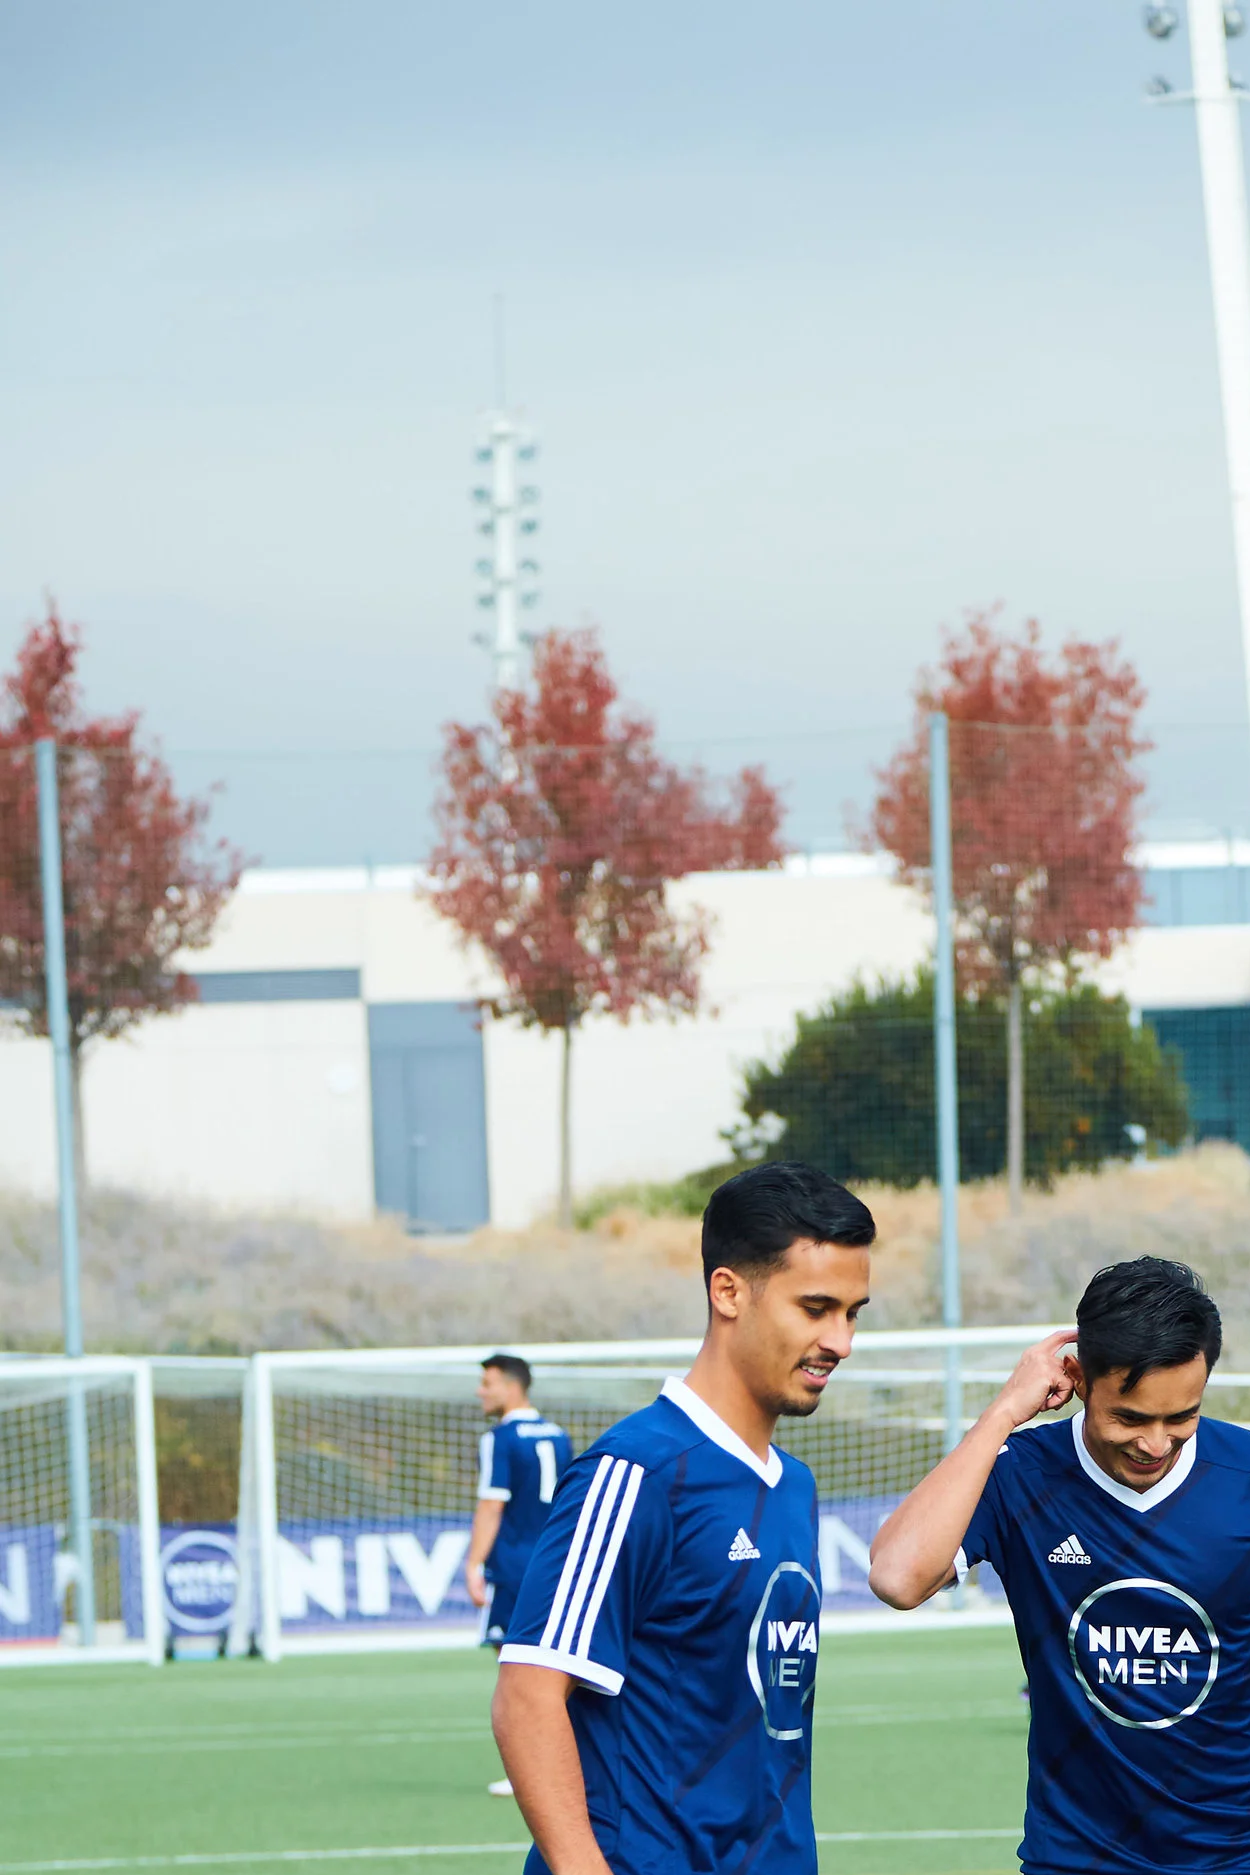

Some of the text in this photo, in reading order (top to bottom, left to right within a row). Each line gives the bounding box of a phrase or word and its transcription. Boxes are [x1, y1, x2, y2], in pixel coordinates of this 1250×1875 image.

[728, 1548, 761, 1562] adidas
[1047, 1552, 1092, 1565] adidas
[277, 1529, 473, 1619] NIV
[1088, 1624, 1201, 1654] NIVEA
[1098, 1657, 1189, 1685] MEN
